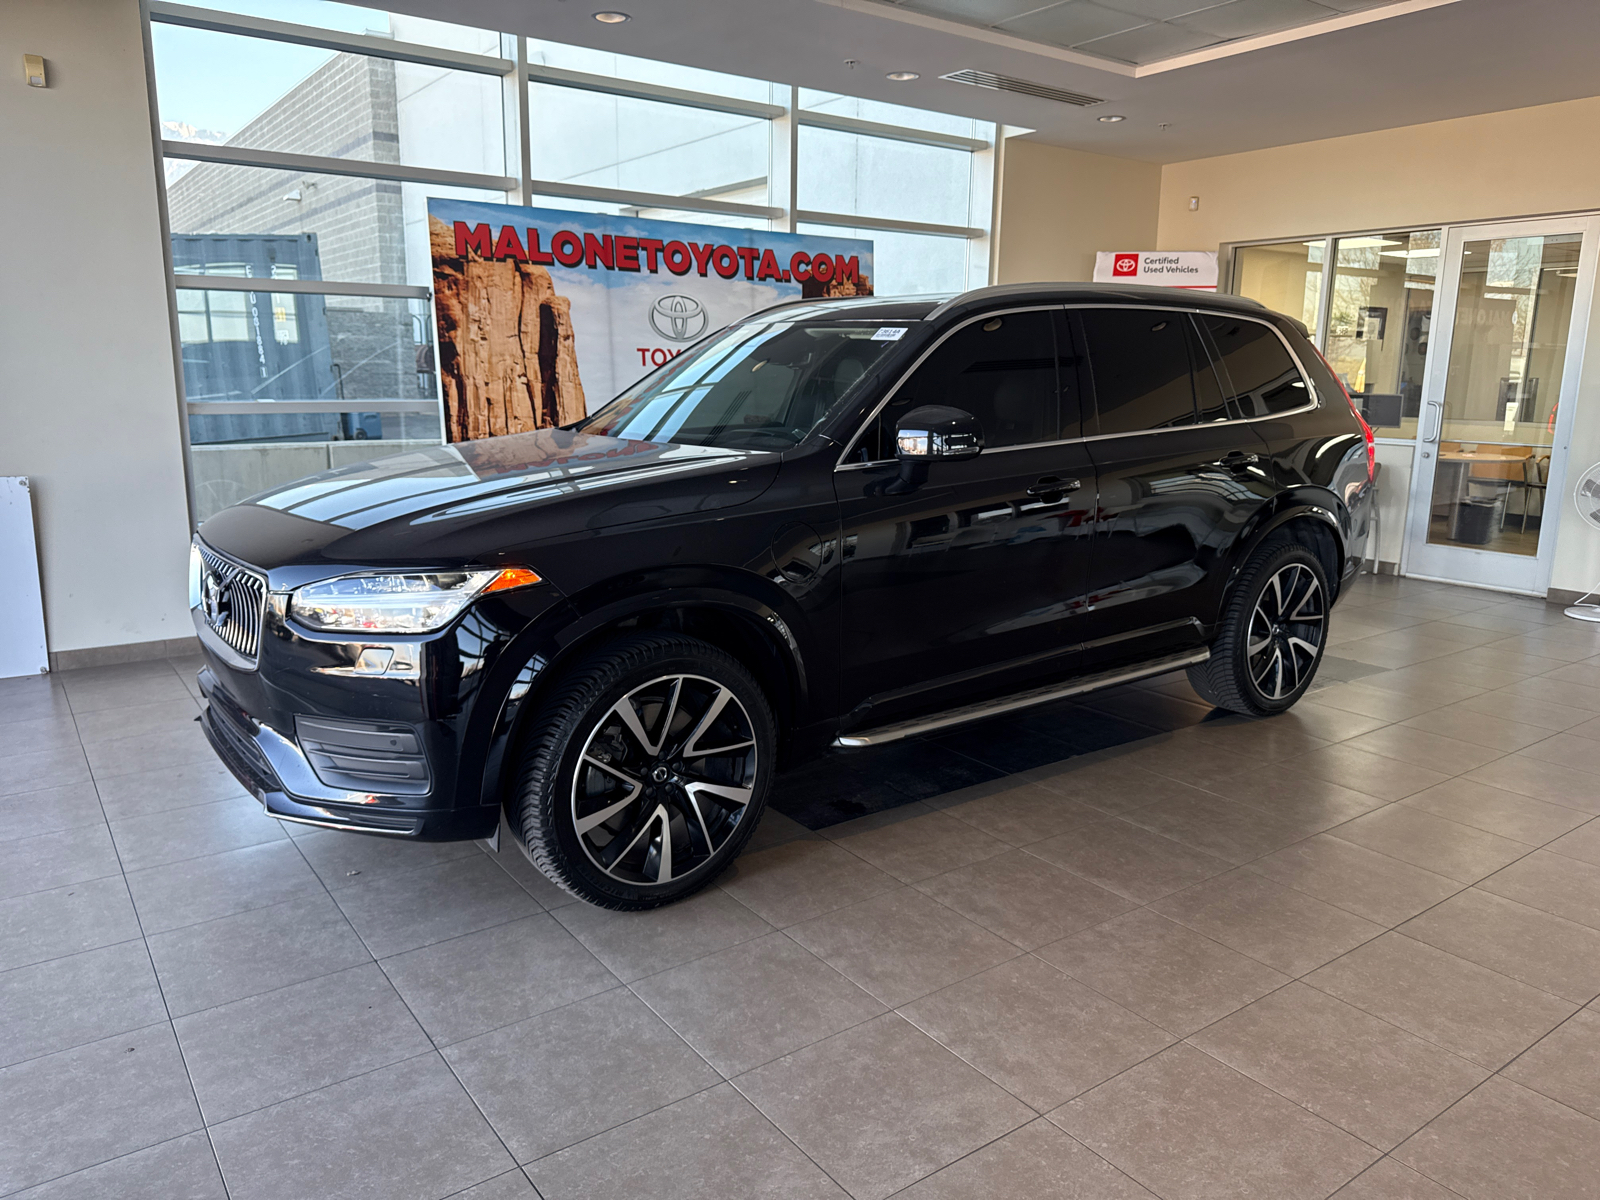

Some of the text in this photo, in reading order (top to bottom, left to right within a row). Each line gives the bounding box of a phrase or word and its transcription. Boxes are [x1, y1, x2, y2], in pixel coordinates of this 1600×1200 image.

[453, 221, 859, 285] MALONETOYOTA.COM
[1144, 257, 1180, 265] Certified
[1143, 265, 1199, 274] Used Vehicles
